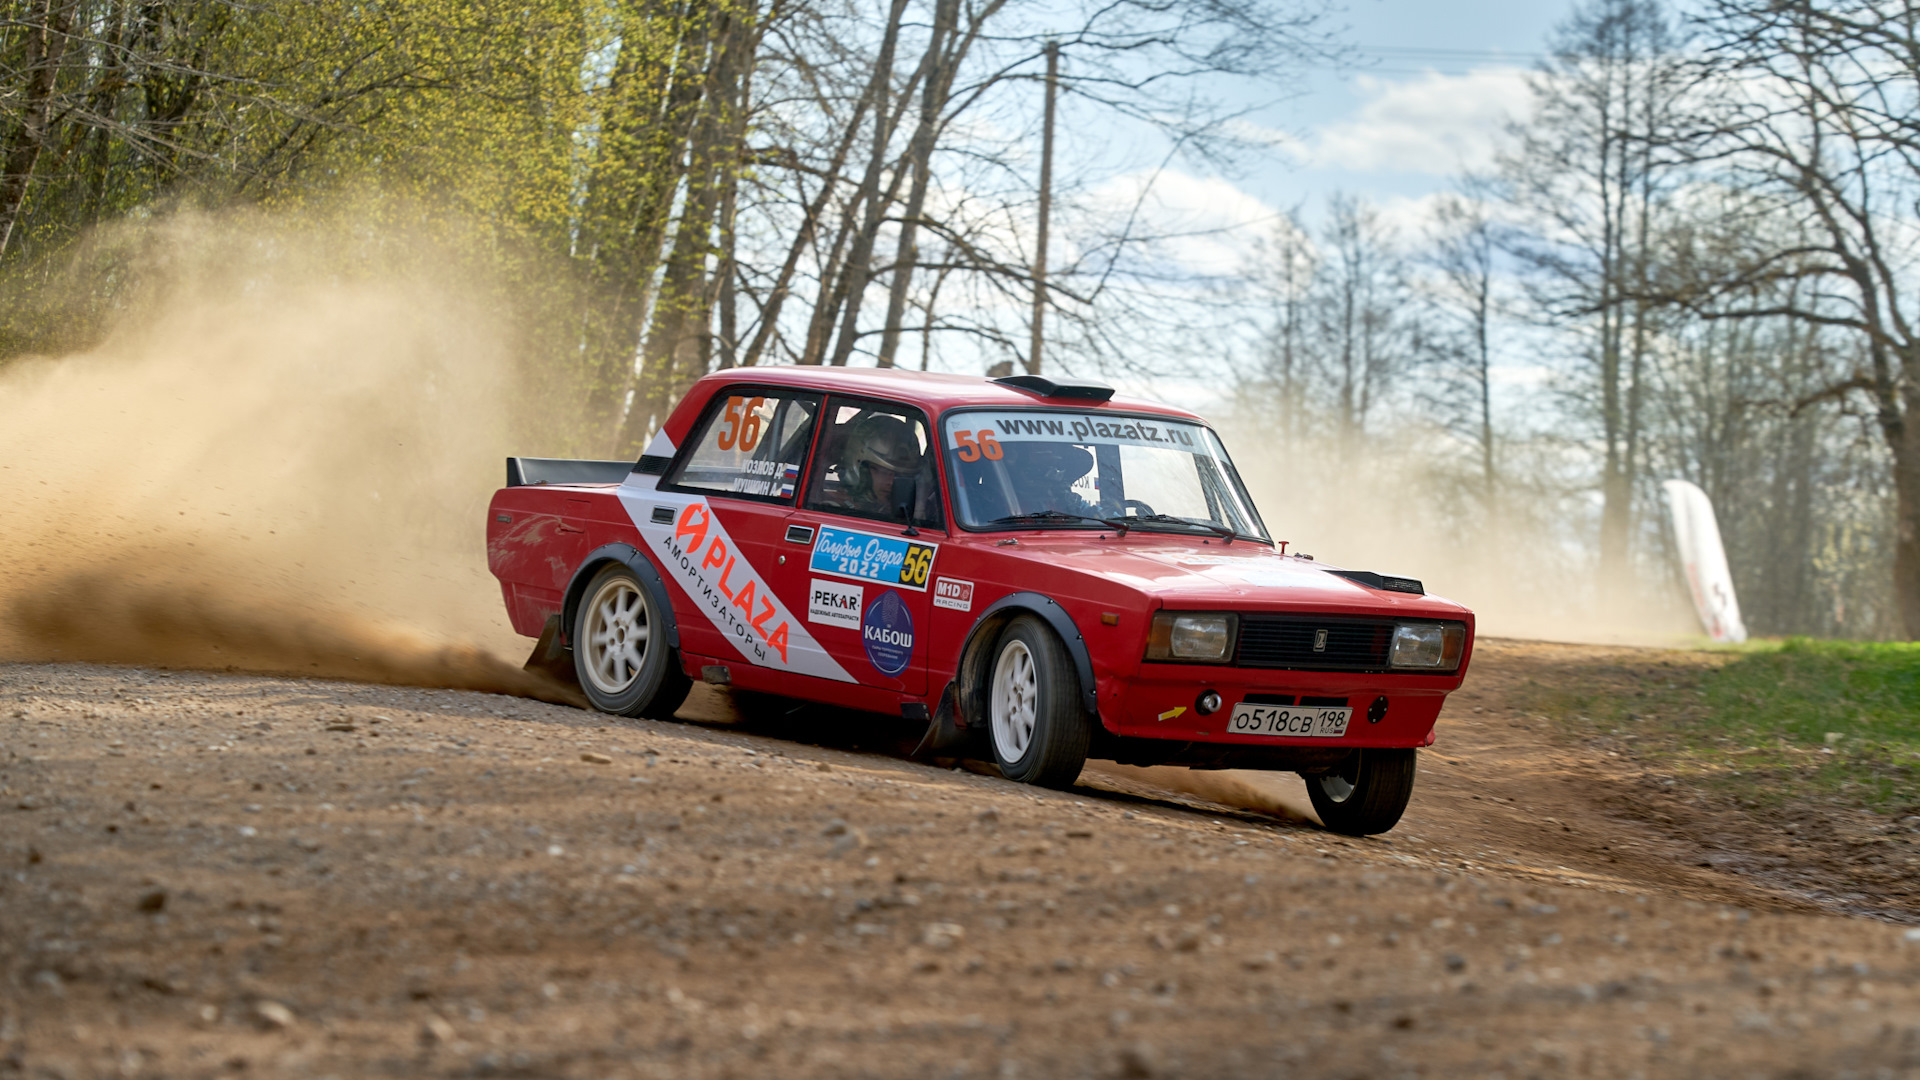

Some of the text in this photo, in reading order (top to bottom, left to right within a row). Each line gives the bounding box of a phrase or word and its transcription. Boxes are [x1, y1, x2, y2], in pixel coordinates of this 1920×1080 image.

[718, 396, 764, 452] 56
[996, 417, 1194, 447] www.plazatz.ru
[954, 429, 1004, 463] 56
[741, 459, 775, 476] КОЗЛОВ
[816, 532, 904, 570] Голубые Озера
[900, 546, 932, 585] 56
[838, 557, 880, 578] 2022
[663, 536, 766, 661] АМОРТИЗАТОРЫ
[701, 534, 789, 665] PLAZA
[936, 599, 968, 609] RACING
[937, 582, 961, 597] M1D
[864, 624, 912, 648] КАБОШ
[1319, 711, 1345, 728] 198
